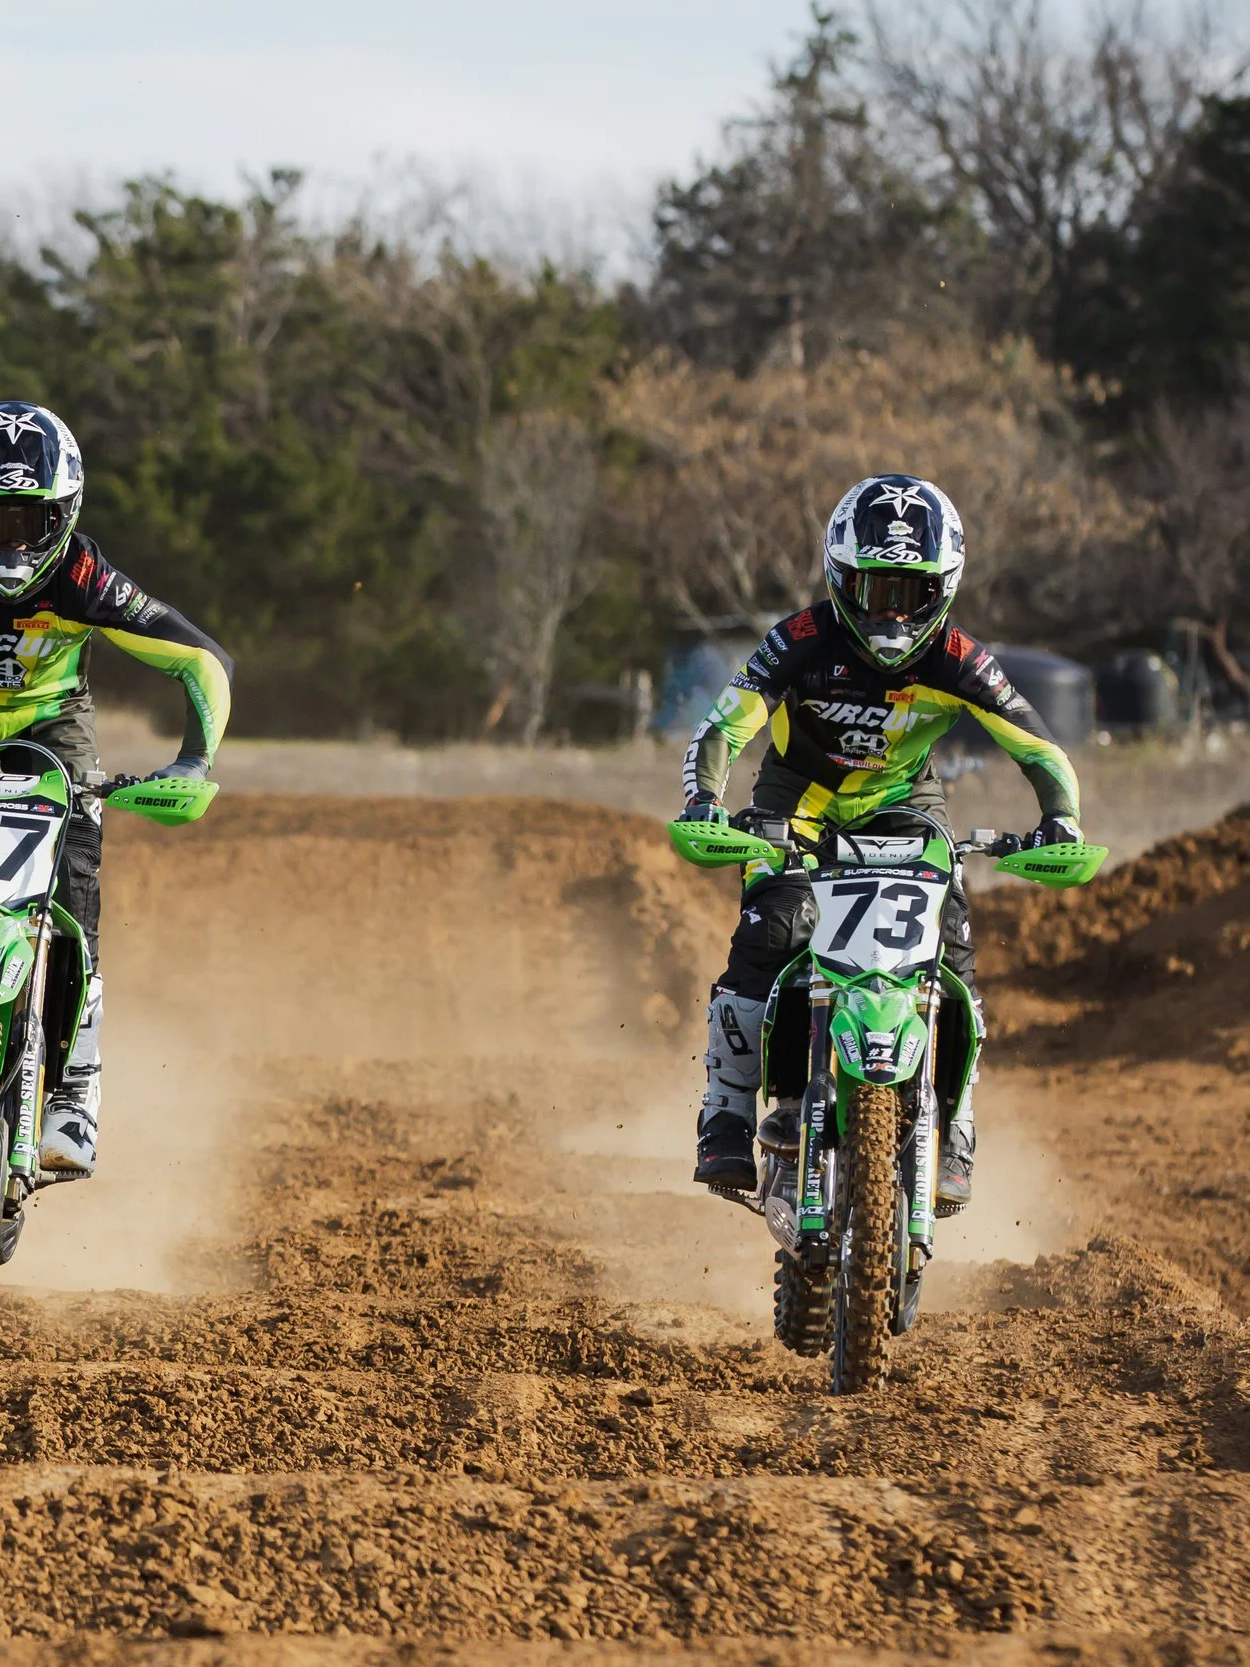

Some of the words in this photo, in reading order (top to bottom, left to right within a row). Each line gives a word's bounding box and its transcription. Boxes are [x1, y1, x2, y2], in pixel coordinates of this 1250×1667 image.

[682, 685, 741, 805] CIRCUI
[852, 761, 887, 770] BUILDIN
[134, 796, 179, 808] CIRCUIT
[706, 844, 750, 854] CIRCUIT
[843, 868, 914, 877] SUPERCROSS
[1023, 863, 1069, 874] CIRCUIT
[827, 880, 930, 953] 73
[869, 1048, 894, 1058] #1
[858, 1063, 904, 1074] LUXON
[21, 1050, 37, 1102] SECRE
[811, 1099, 826, 1133] TOP
[19, 1106, 33, 1138] TOP
[916, 1114, 929, 1168] SECRE
[797, 1206, 825, 1216] EVOL
